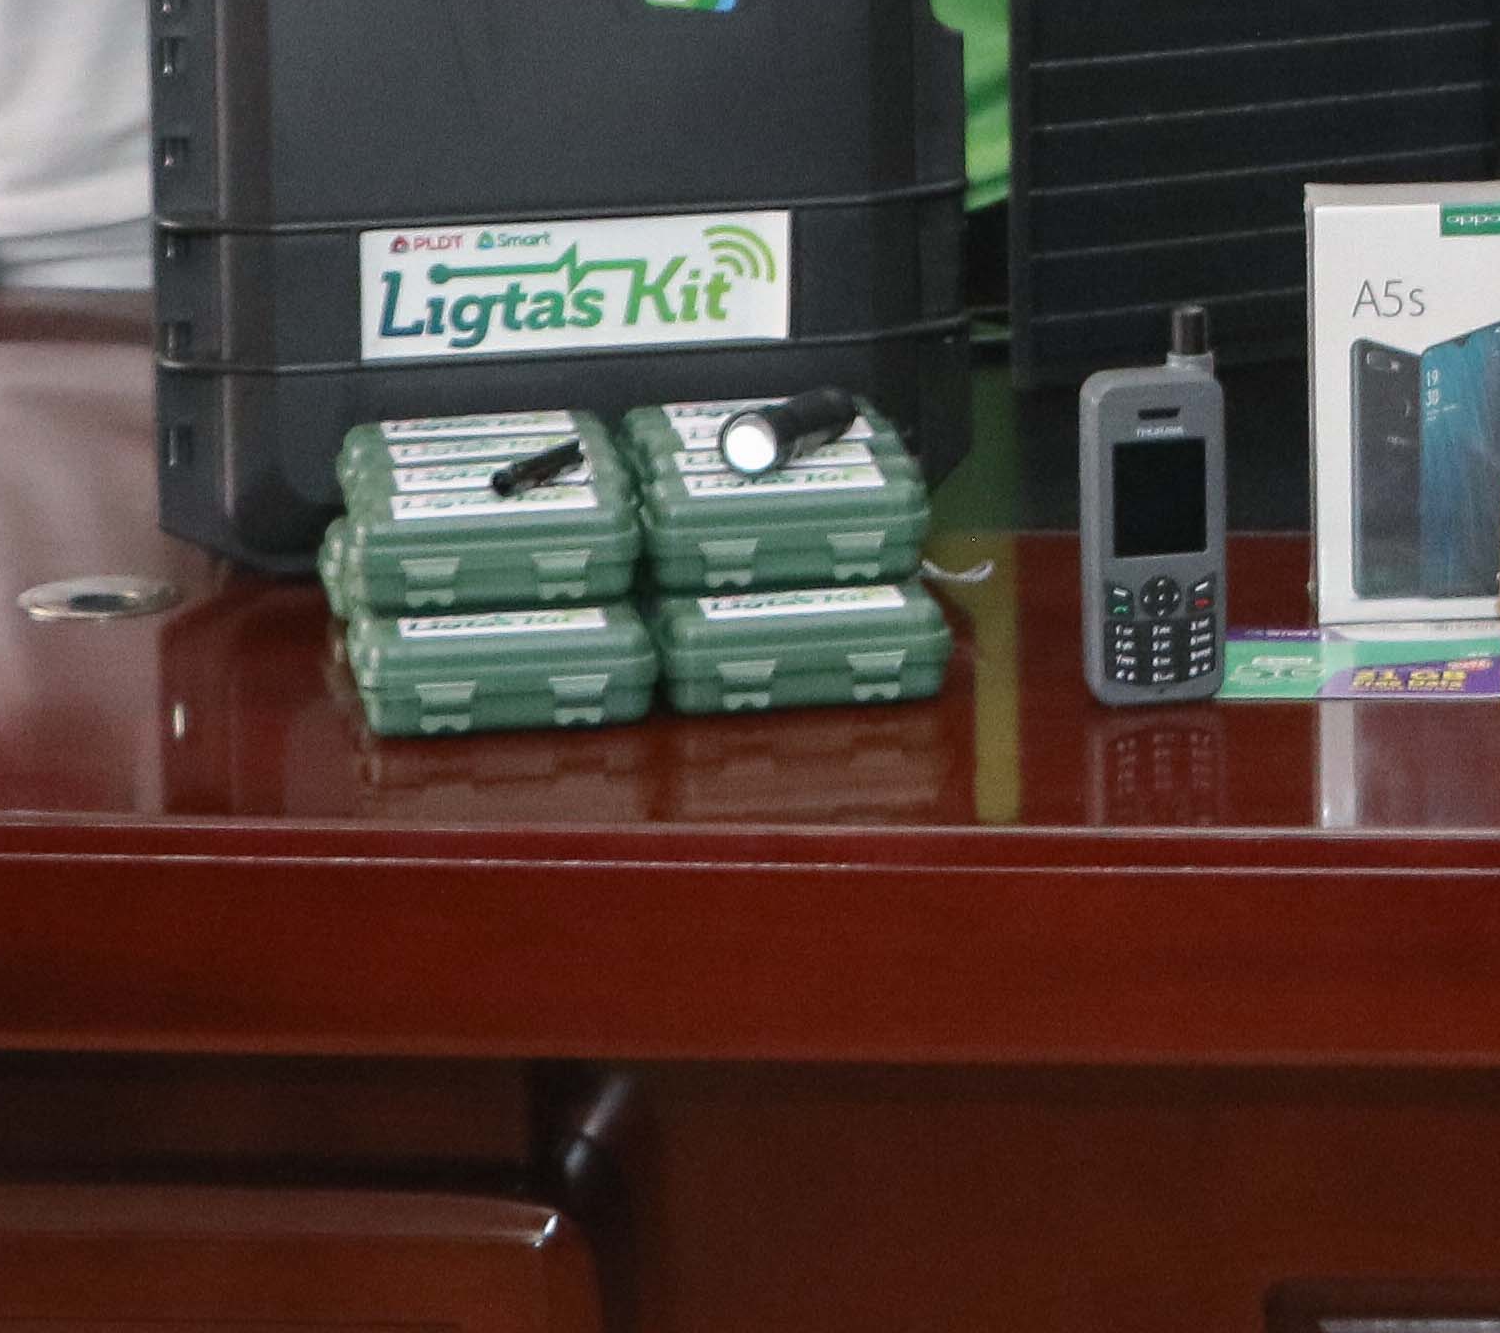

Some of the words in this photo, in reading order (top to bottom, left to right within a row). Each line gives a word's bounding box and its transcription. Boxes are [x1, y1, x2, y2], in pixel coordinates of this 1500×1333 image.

[413, 234, 465, 252] PLDT
[497, 231, 552, 249] Smart
[378, 262, 604, 350] Ligtas
[623, 255, 734, 327] Kit
[1352, 278, 1426, 318] A5s
